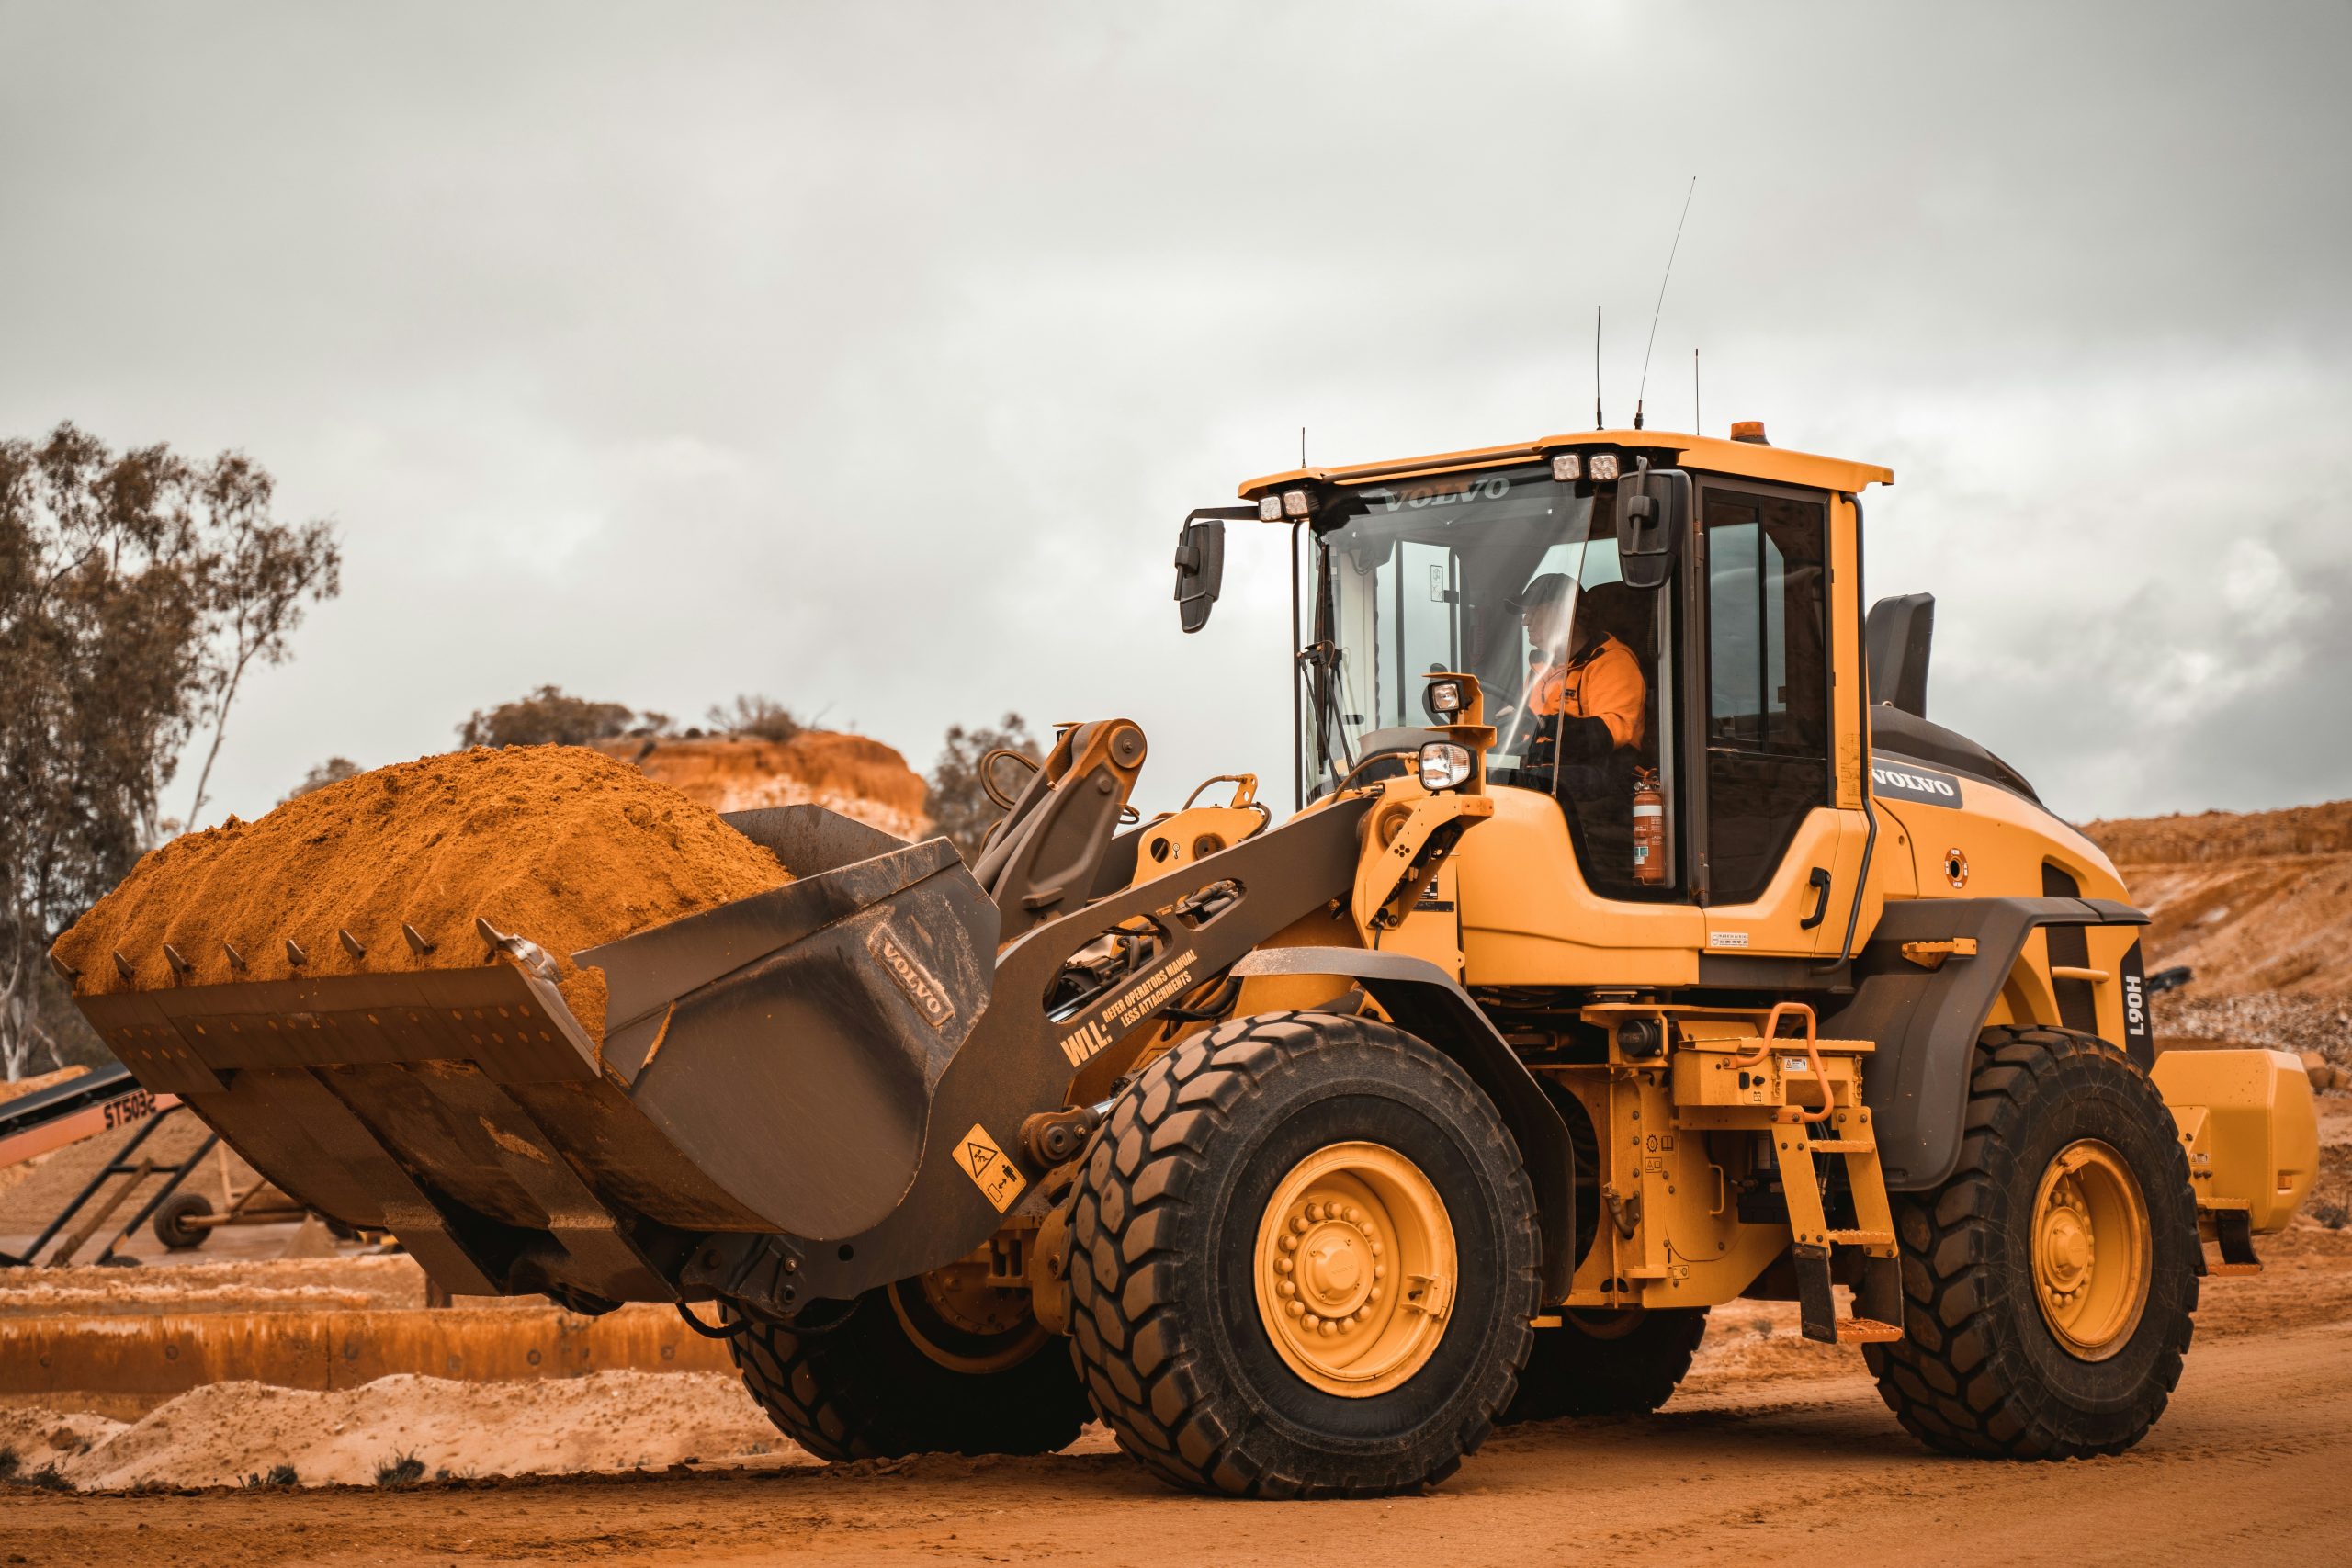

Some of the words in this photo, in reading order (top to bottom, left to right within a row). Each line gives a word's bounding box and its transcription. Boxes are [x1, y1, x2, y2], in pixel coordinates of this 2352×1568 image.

[1382, 477, 1510, 512] VOLVO
[1871, 768, 1954, 797] VOLVO
[884, 941, 941, 1013] VOLVO
[1102, 998, 1127, 1023] REFER
[1124, 970, 1168, 1007] OPERATORS
[1165, 948, 1197, 978] MANUAL
[1120, 1006, 1141, 1028] LESS
[1138, 970, 1193, 1016] ATTACHMENTS
[2125, 976, 2144, 1036] L90H
[1060, 1021, 1113, 1067] WLL:
